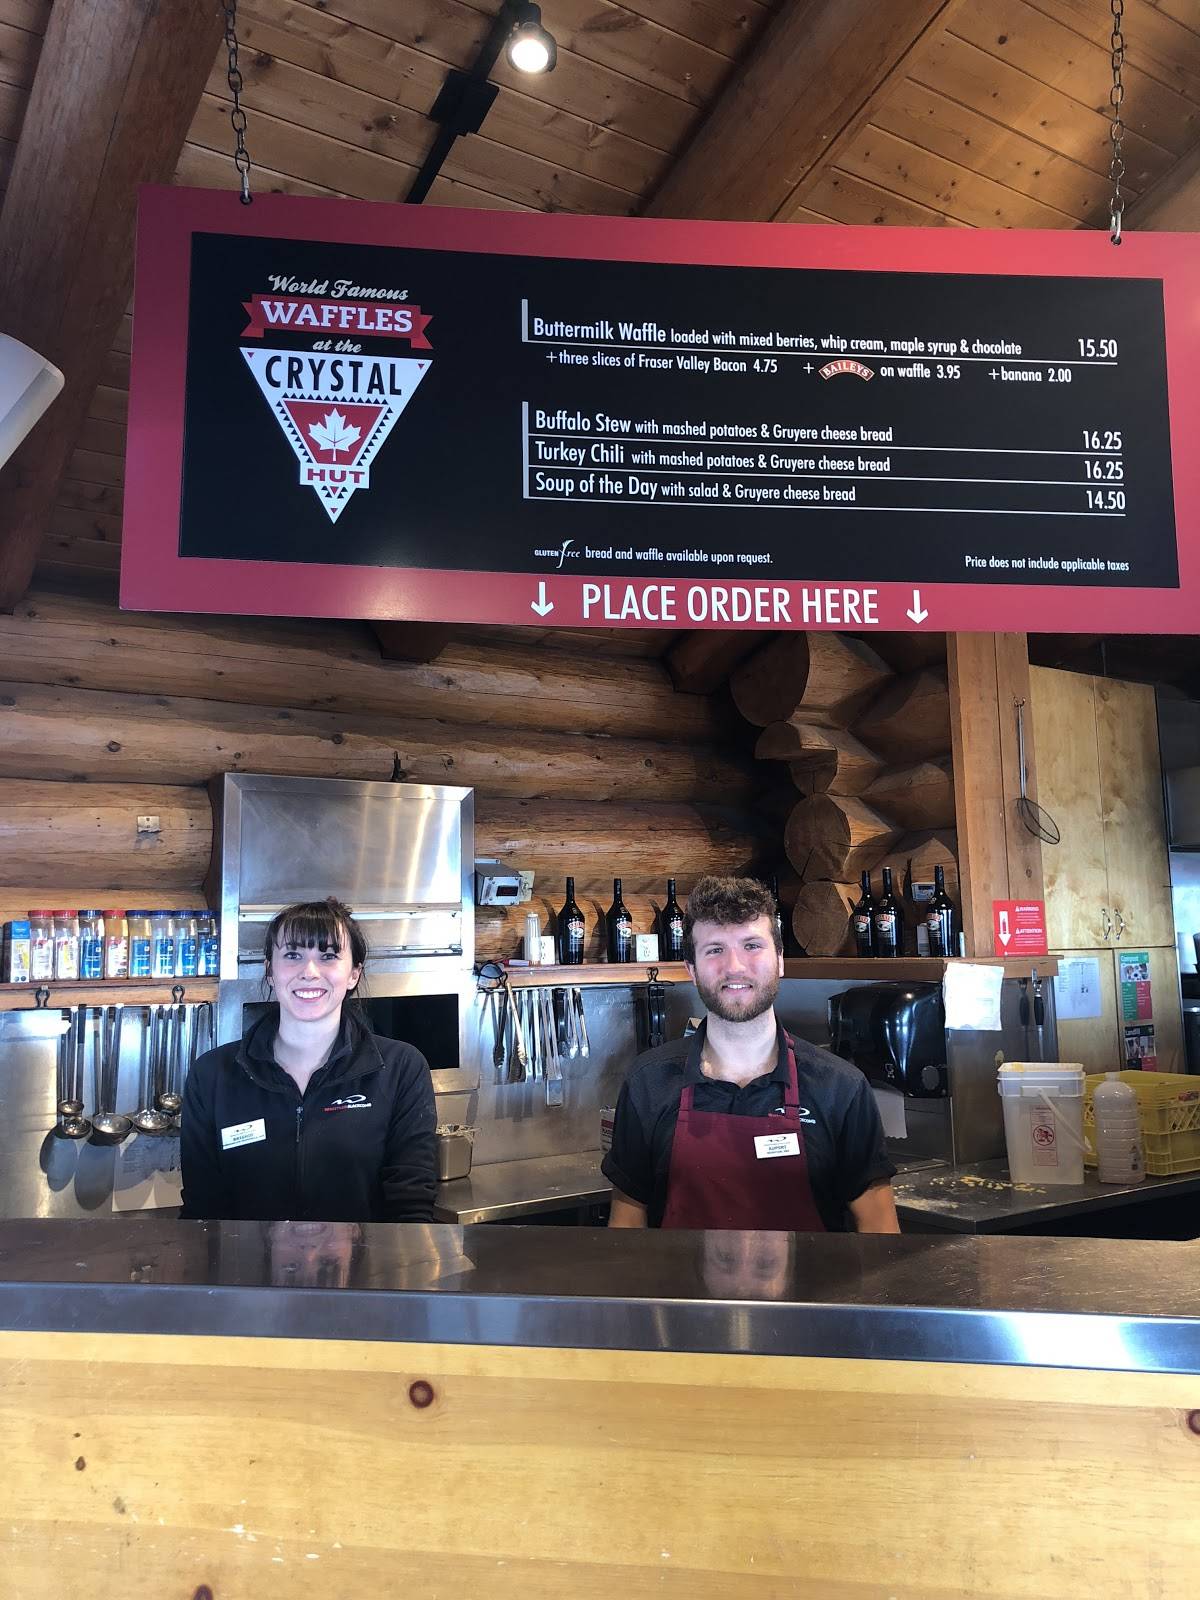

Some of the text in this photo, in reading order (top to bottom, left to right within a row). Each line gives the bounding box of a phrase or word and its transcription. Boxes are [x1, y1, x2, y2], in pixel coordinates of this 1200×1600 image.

[268, 275, 408, 300] World Famous
[260, 301, 413, 333] WAFFLES
[312, 339, 362, 353] at the
[533, 317, 1117, 357] Buttermilk Waffle loaded with mixed berries, whip cream, maple syrup & chocolate 15.50
[265, 355, 403, 396] CRYSTAL
[592, 352, 620, 366] slices
[624, 353, 635, 367] of
[639, 354, 673, 368] Fraser
[676, 356, 710, 373] Valley
[714, 357, 746, 371] Bacon
[754, 359, 777, 372] 4.75
[822, 361, 871, 377] BAILEYS
[881, 367, 894, 376] on
[897, 363, 930, 378] waffle
[937, 365, 960, 379] 3.95
[1048, 368, 1071, 382] 2.00
[536, 410, 1122, 450] Buffalo Stew with mashed potatoes & Gruyere cheese bread 16.25
[306, 468, 366, 484] HUT
[535, 441, 1123, 479] Turkey Chili with mashed potatoes & Gruyere cheese bread 16.25
[535, 472, 1125, 509] Soup of the Day with salad & Gruyere cheese bread 14.50
[533, 548, 559, 557] GLUTEN
[586, 546, 612, 558] bread
[615, 548, 632, 559] and
[636, 548, 663, 560] waffle
[666, 549, 708, 561] available
[711, 552, 735, 566] upon
[737, 553, 772, 565] request.
[966, 555, 1131, 572] Price does not include applicable taxes
[583, 584, 878, 623] PLACE ORDER HERE
